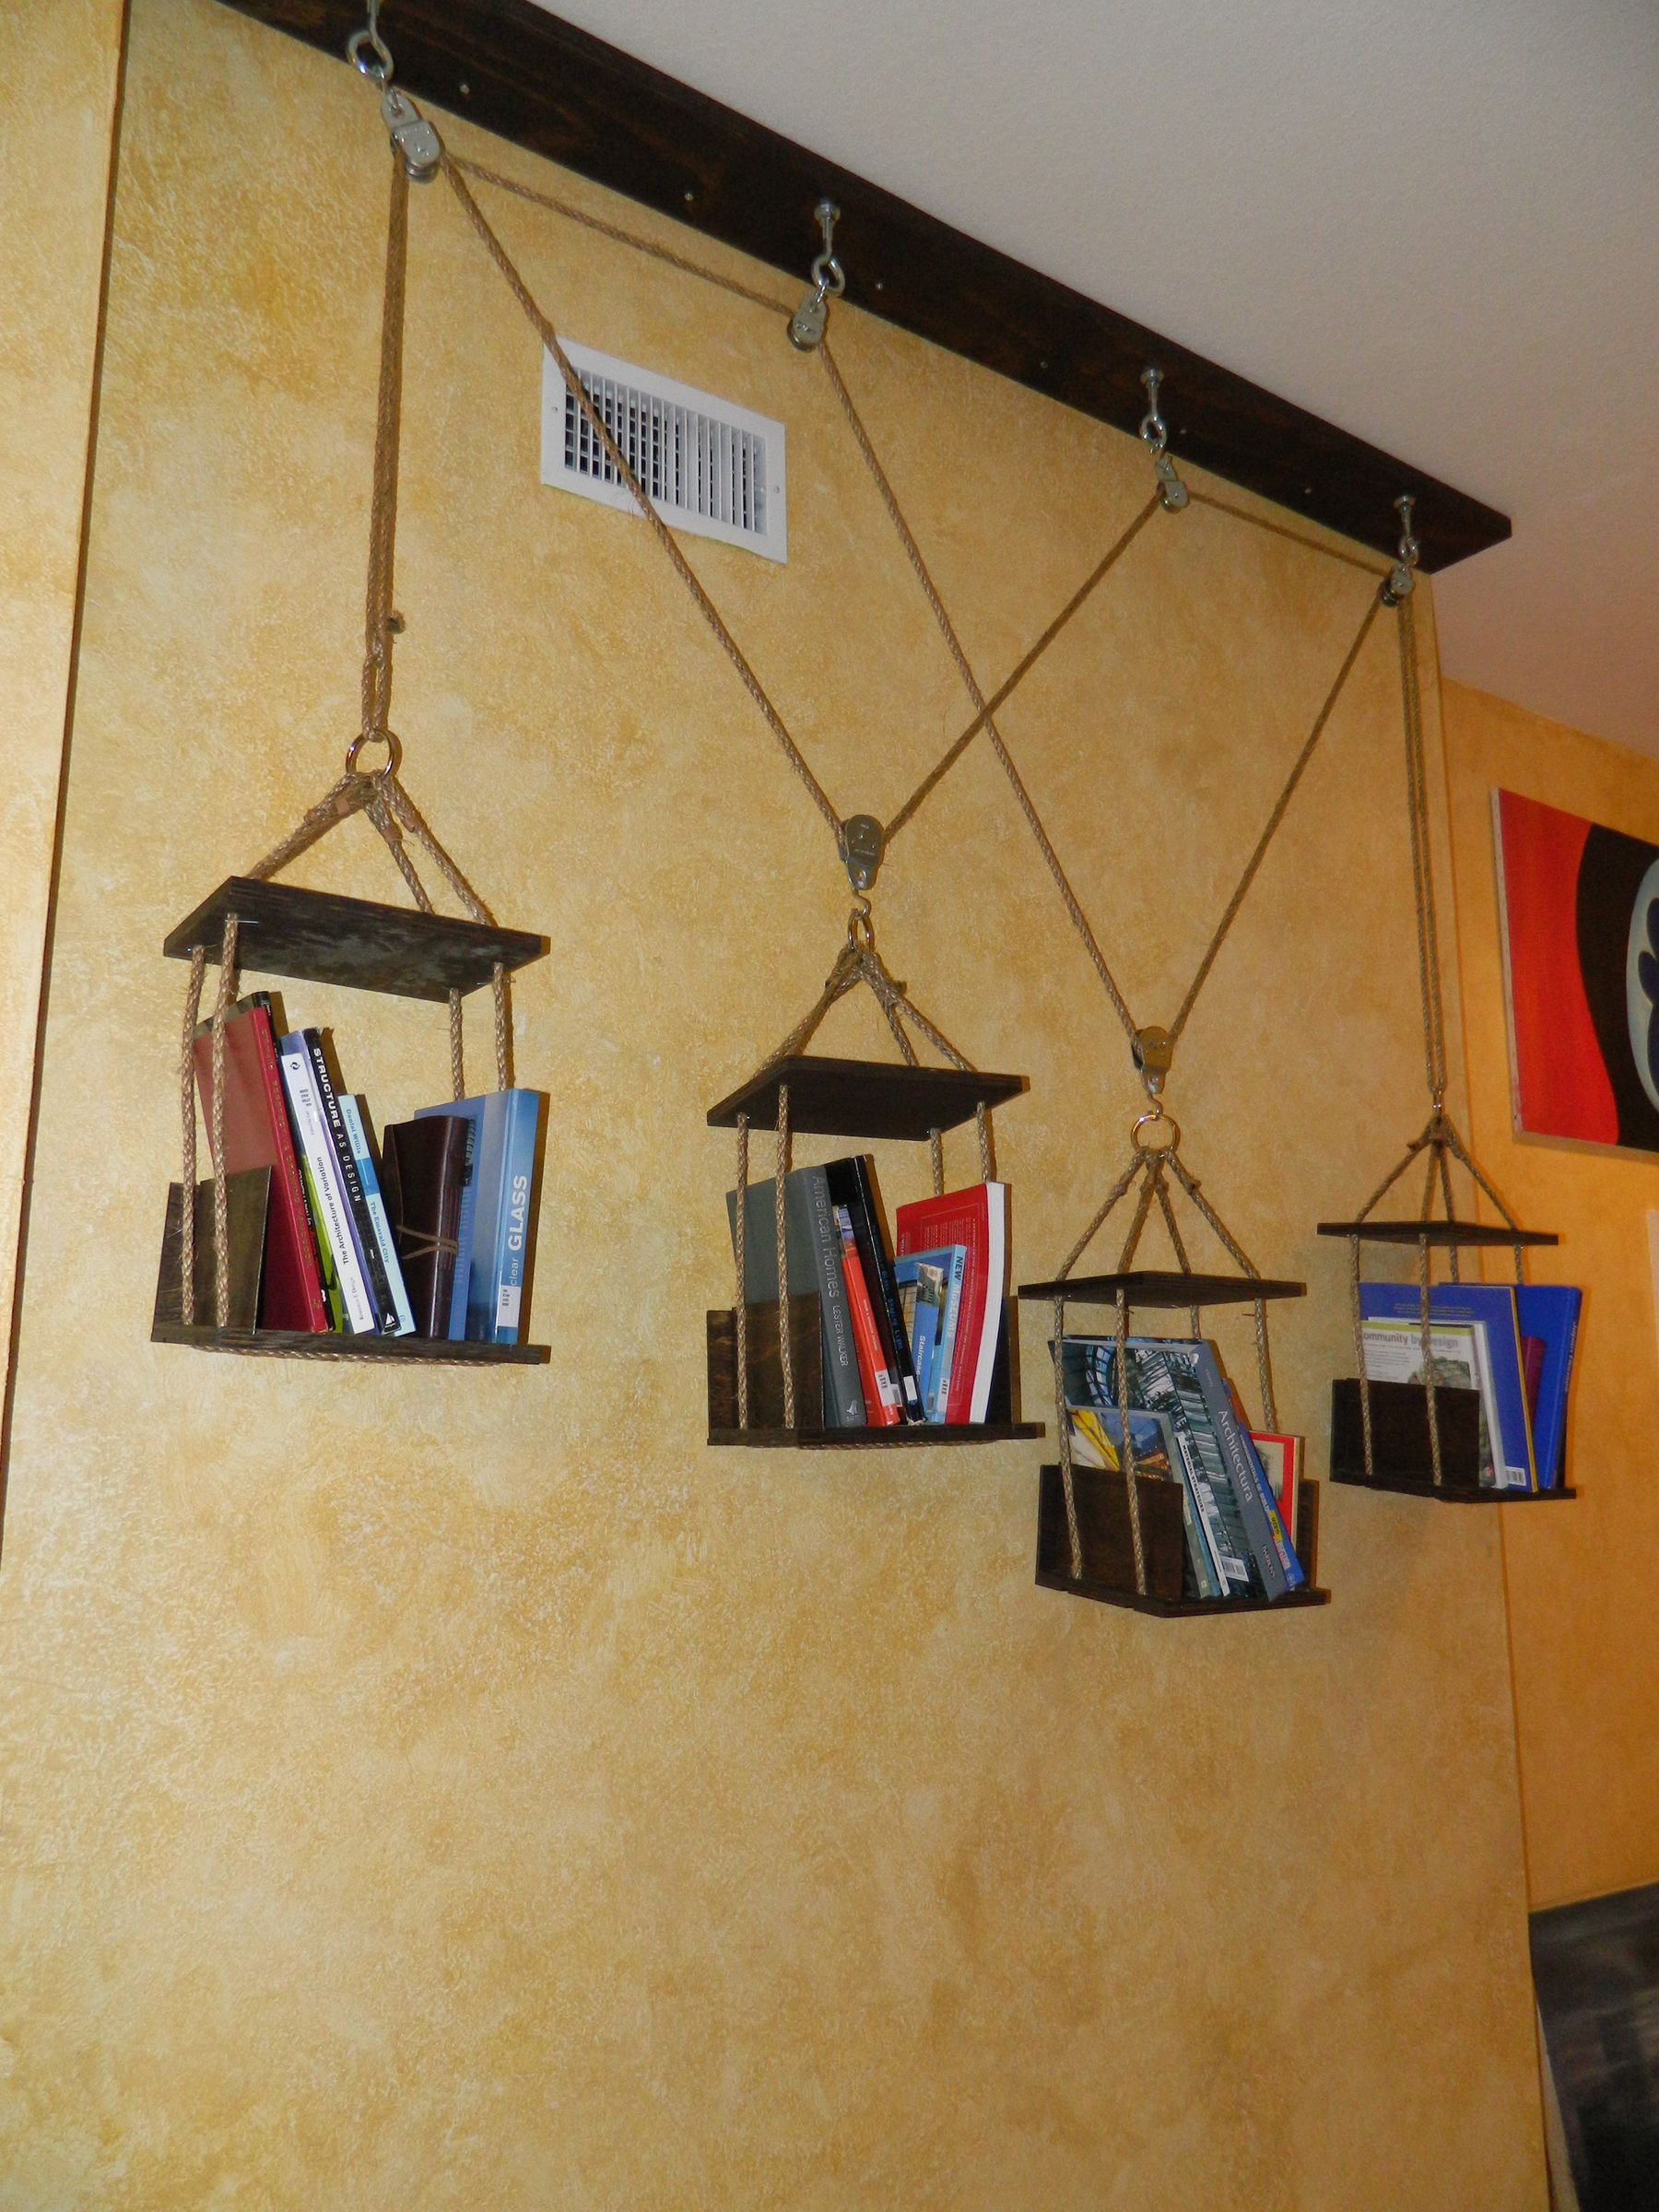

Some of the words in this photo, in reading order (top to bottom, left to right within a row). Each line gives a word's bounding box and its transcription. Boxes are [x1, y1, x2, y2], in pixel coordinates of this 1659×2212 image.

[313, 1048, 341, 1128] STRUCTURE
[336, 1133, 347, 1147] AS
[342, 1155, 361, 1202] DESIGN
[317, 1157, 330, 1192] Variation
[326, 1193, 335, 1202] of
[508, 1174, 528, 1252] GLASS
[331, 1205, 347, 1251] Architecture
[373, 1216, 386, 1245] Emerald
[382, 1245, 390, 1264] City
[342, 1251, 350, 1265] The
[510, 1257, 519, 1287] clear
[812, 1175, 832, 1240] American
[822, 1242, 840, 1298] Homes
[832, 1305, 842, 1335] LESTER
[837, 1335, 849, 1367] WALKER
[954, 1255, 965, 1281] NEW
[1362, 1331, 1408, 1346] ommunity
[1429, 1335, 1459, 1348] esign
[1218, 1410, 1253, 1502] Architectura
[1182, 1444, 1195, 1476] MATERIAL
[1192, 1475, 1206, 1512] STRATEGIES
[1259, 1491, 1270, 1513] BUILD
